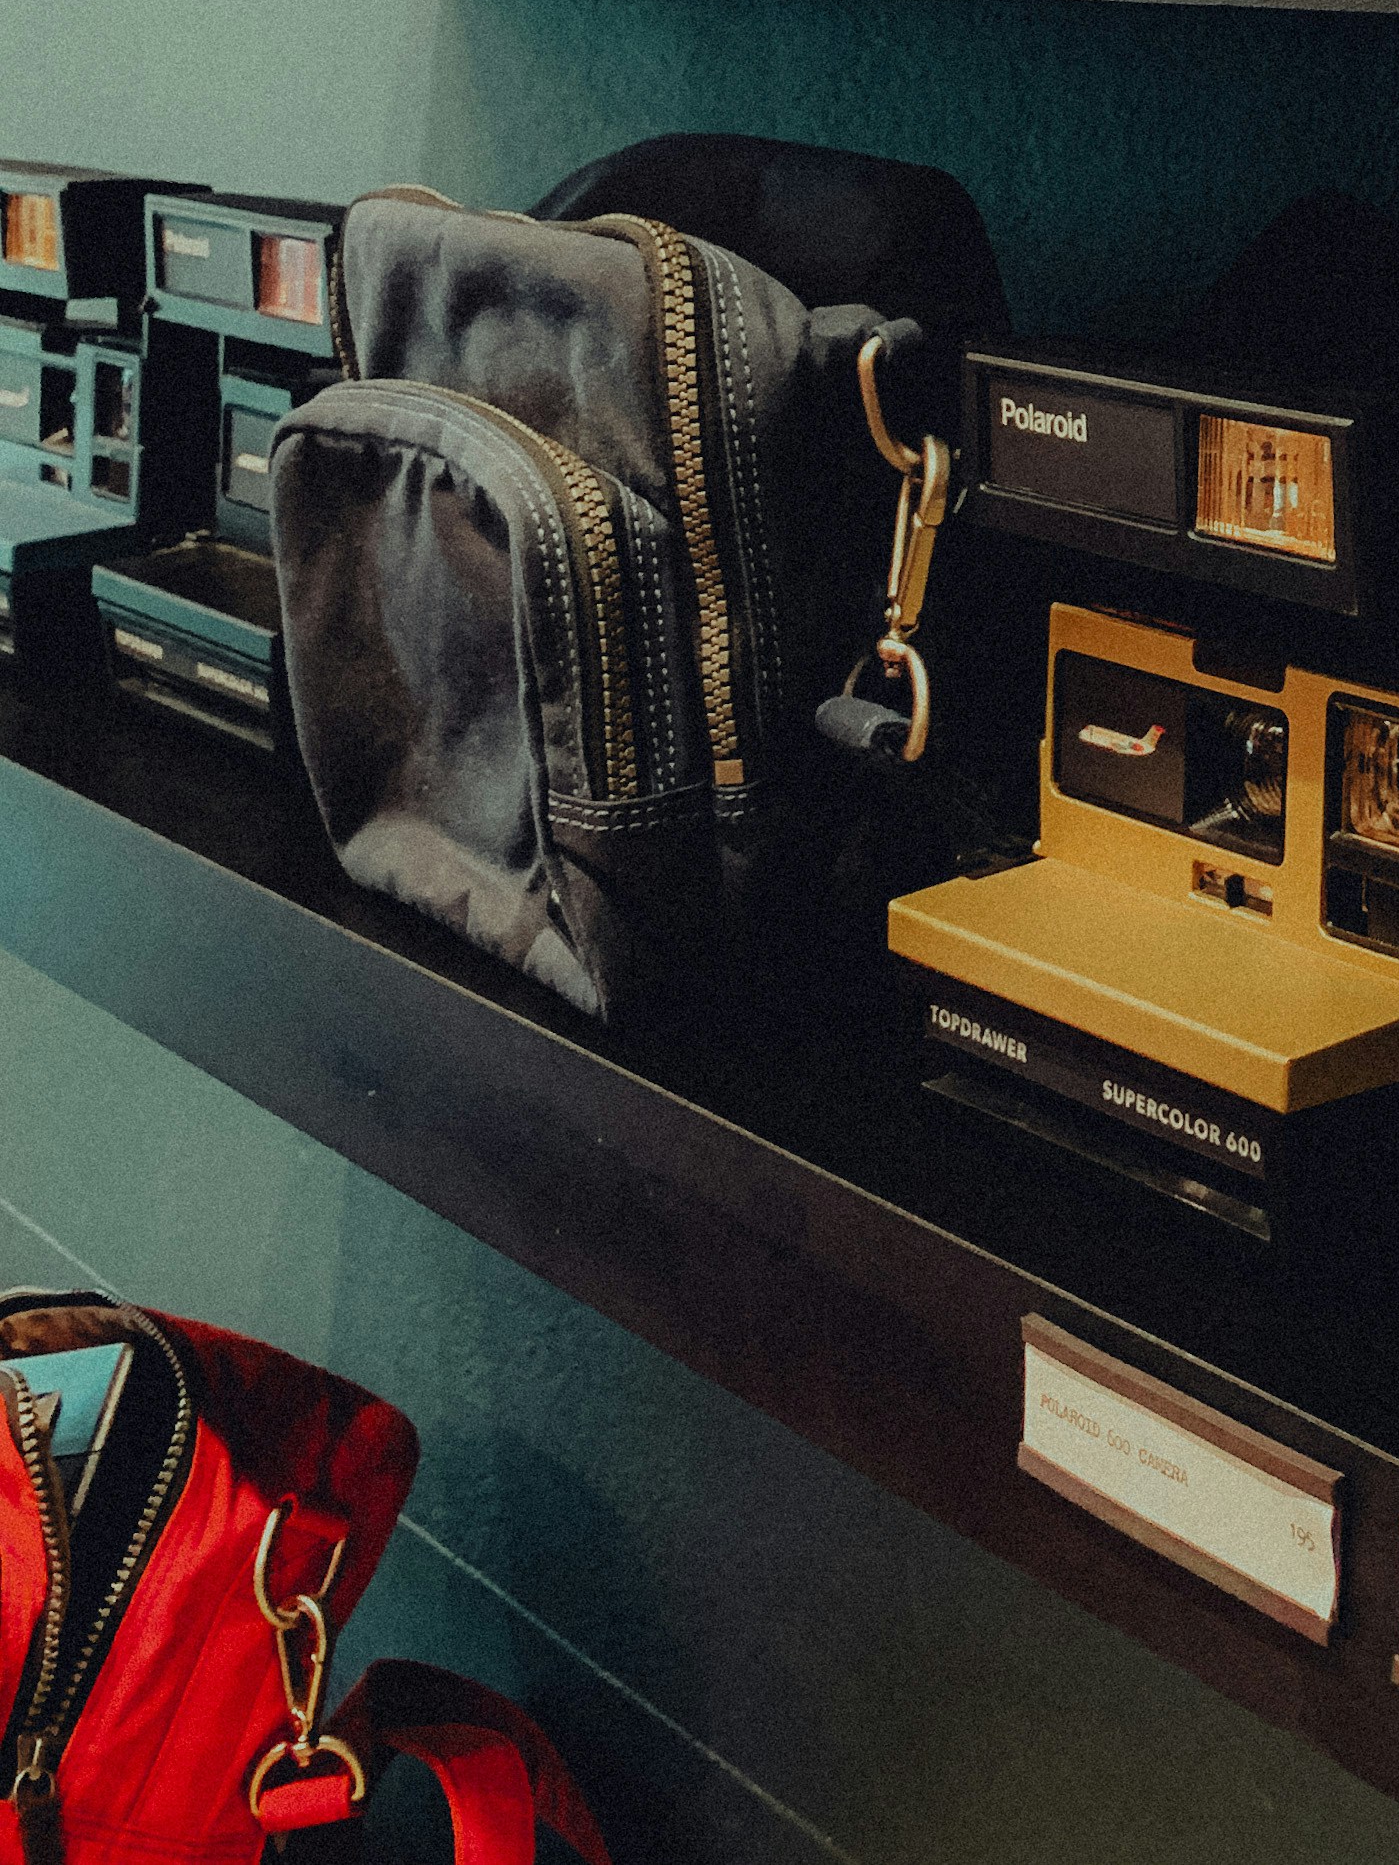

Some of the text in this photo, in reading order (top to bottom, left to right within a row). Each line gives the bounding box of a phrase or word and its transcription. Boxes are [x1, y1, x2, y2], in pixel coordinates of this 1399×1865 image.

[1001, 397, 1087, 442] Polaroid
[930, 1005, 1261, 1163] TOPDRAWER SUPERCOLOR 600
[1039, 1393, 1189, 1487] POLAROID 600 CAMERA
[1290, 1523, 1315, 1551] 195
